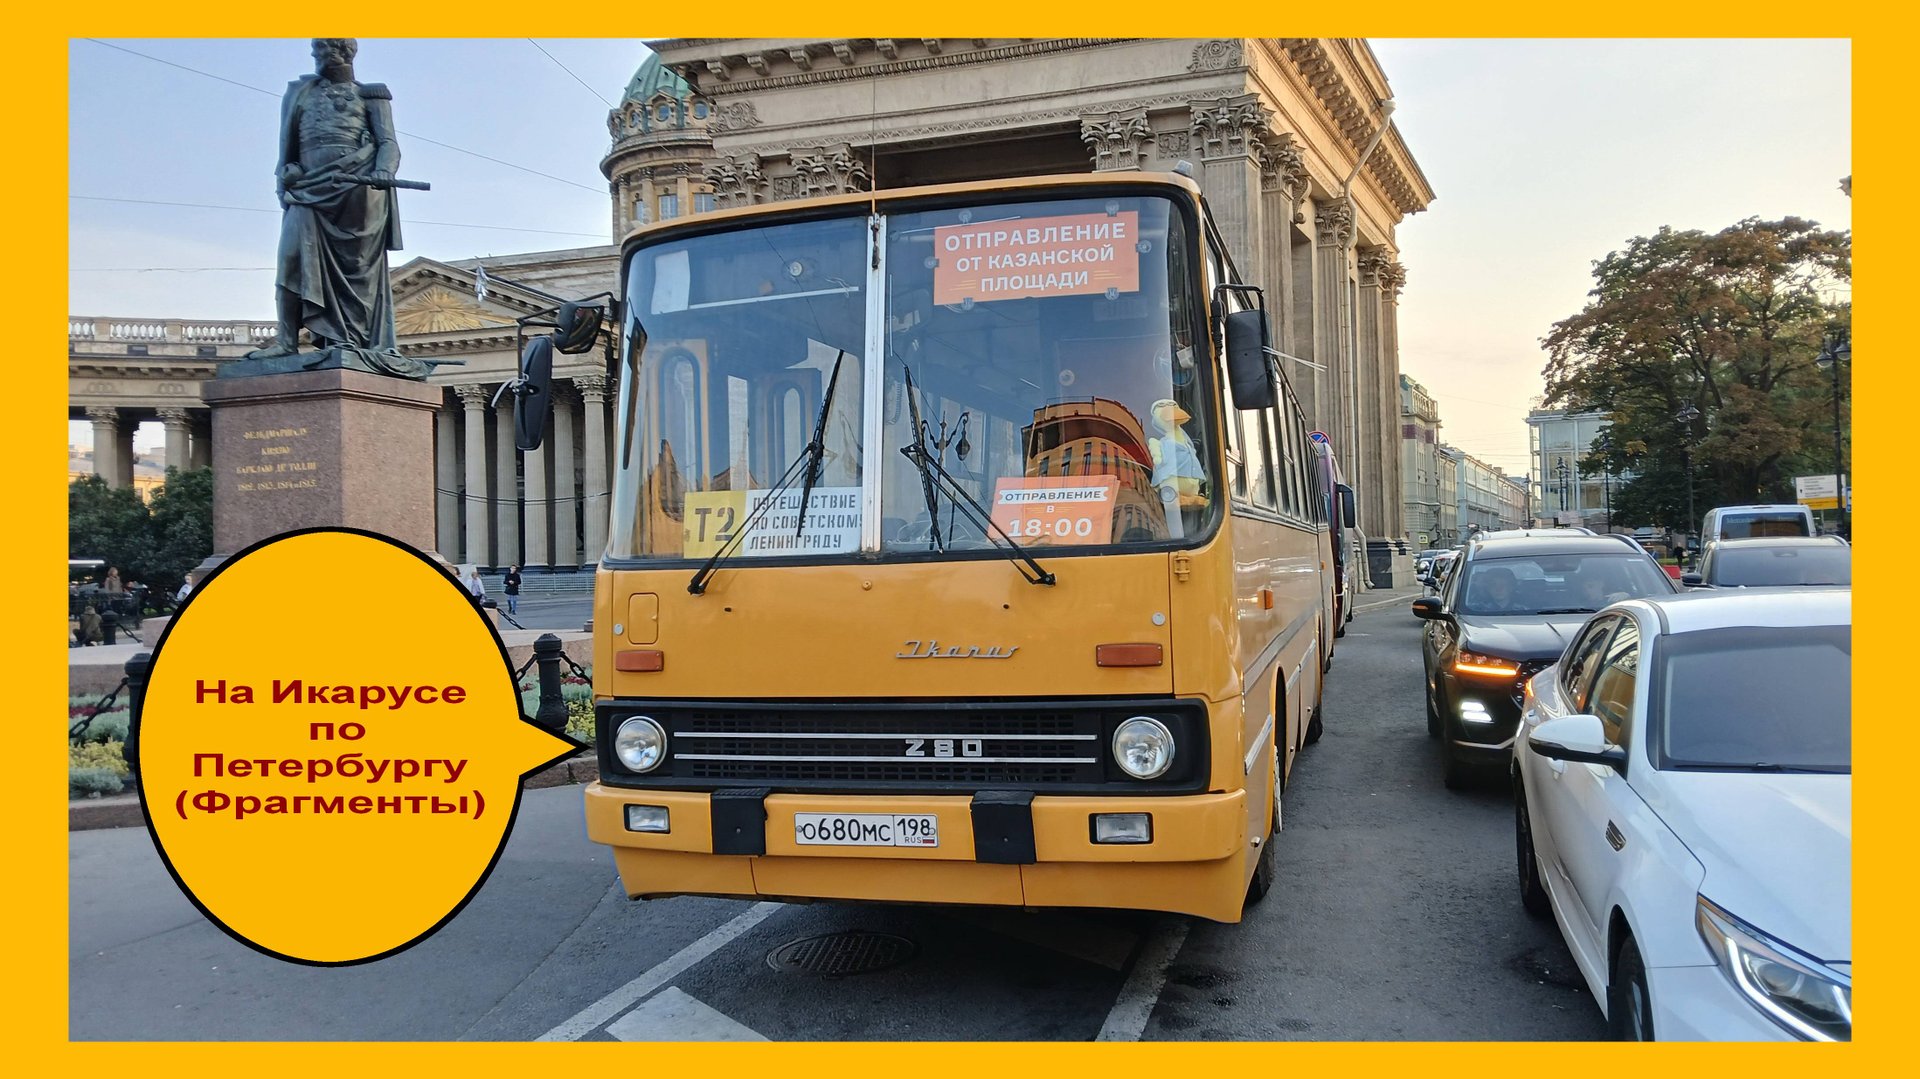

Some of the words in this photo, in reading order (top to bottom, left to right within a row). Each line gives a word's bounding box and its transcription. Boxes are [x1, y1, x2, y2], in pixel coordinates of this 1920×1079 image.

[945, 222, 1126, 251] ОТПРАВЛЕНИЕ
[956, 256, 982, 272] ОТ
[988, 243, 1114, 269] КАЗАНСКОЙ
[980, 271, 1088, 292] ПЛОЩАДИ
[753, 494, 857, 511] ПУТЕШСТВИЕ
[1005, 490, 1101, 501] ОТПРАВЛЕНИЕ
[1046, 505, 1055, 513] В
[695, 506, 735, 542] Т2
[1007, 517, 1093, 537] 18:00
[896, 818, 931, 836] 198
[904, 836, 922, 844] RUS
